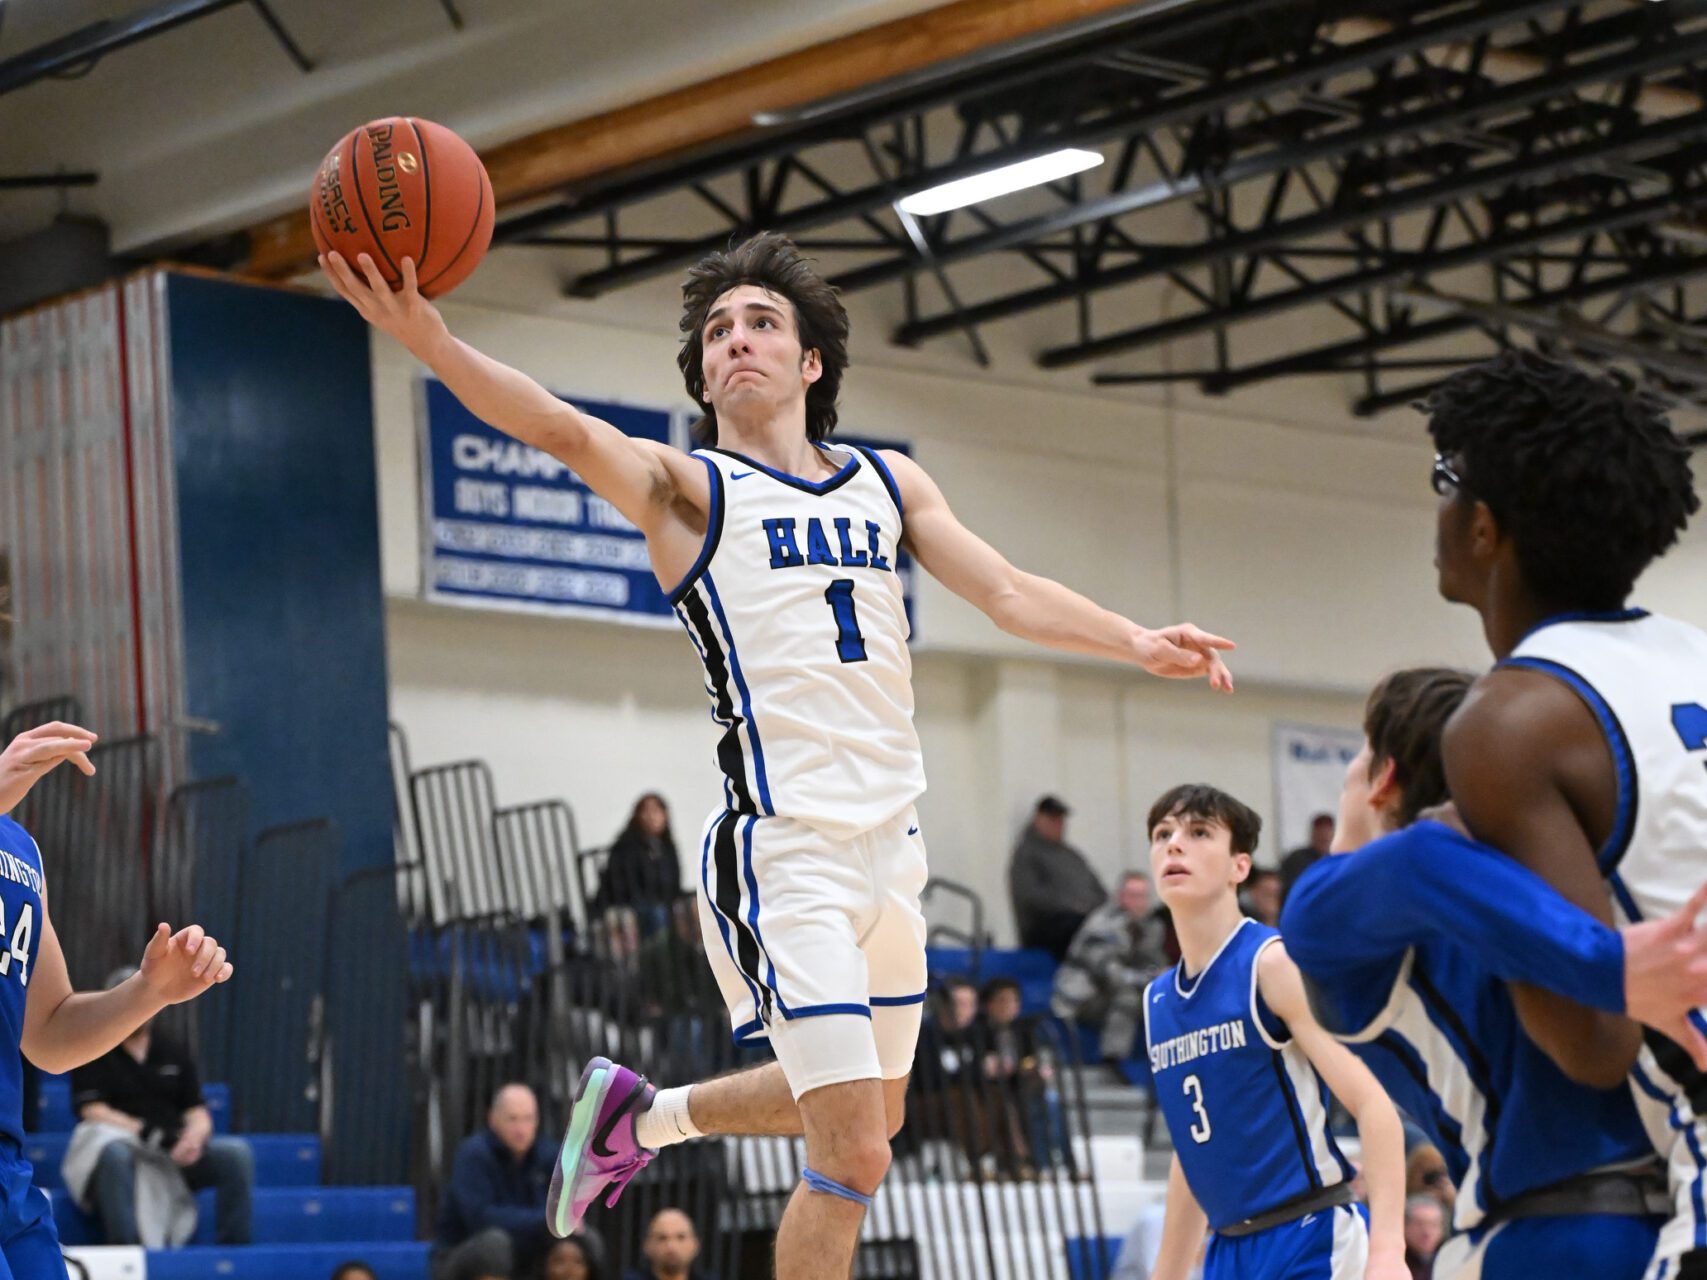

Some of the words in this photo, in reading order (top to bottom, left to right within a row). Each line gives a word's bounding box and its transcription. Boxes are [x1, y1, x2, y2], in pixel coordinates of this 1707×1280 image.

[366, 124, 411, 232] PALDING
[762, 517, 892, 572] HALL
[824, 578, 868, 664] 1
[1182, 1073, 1211, 1145] 3
